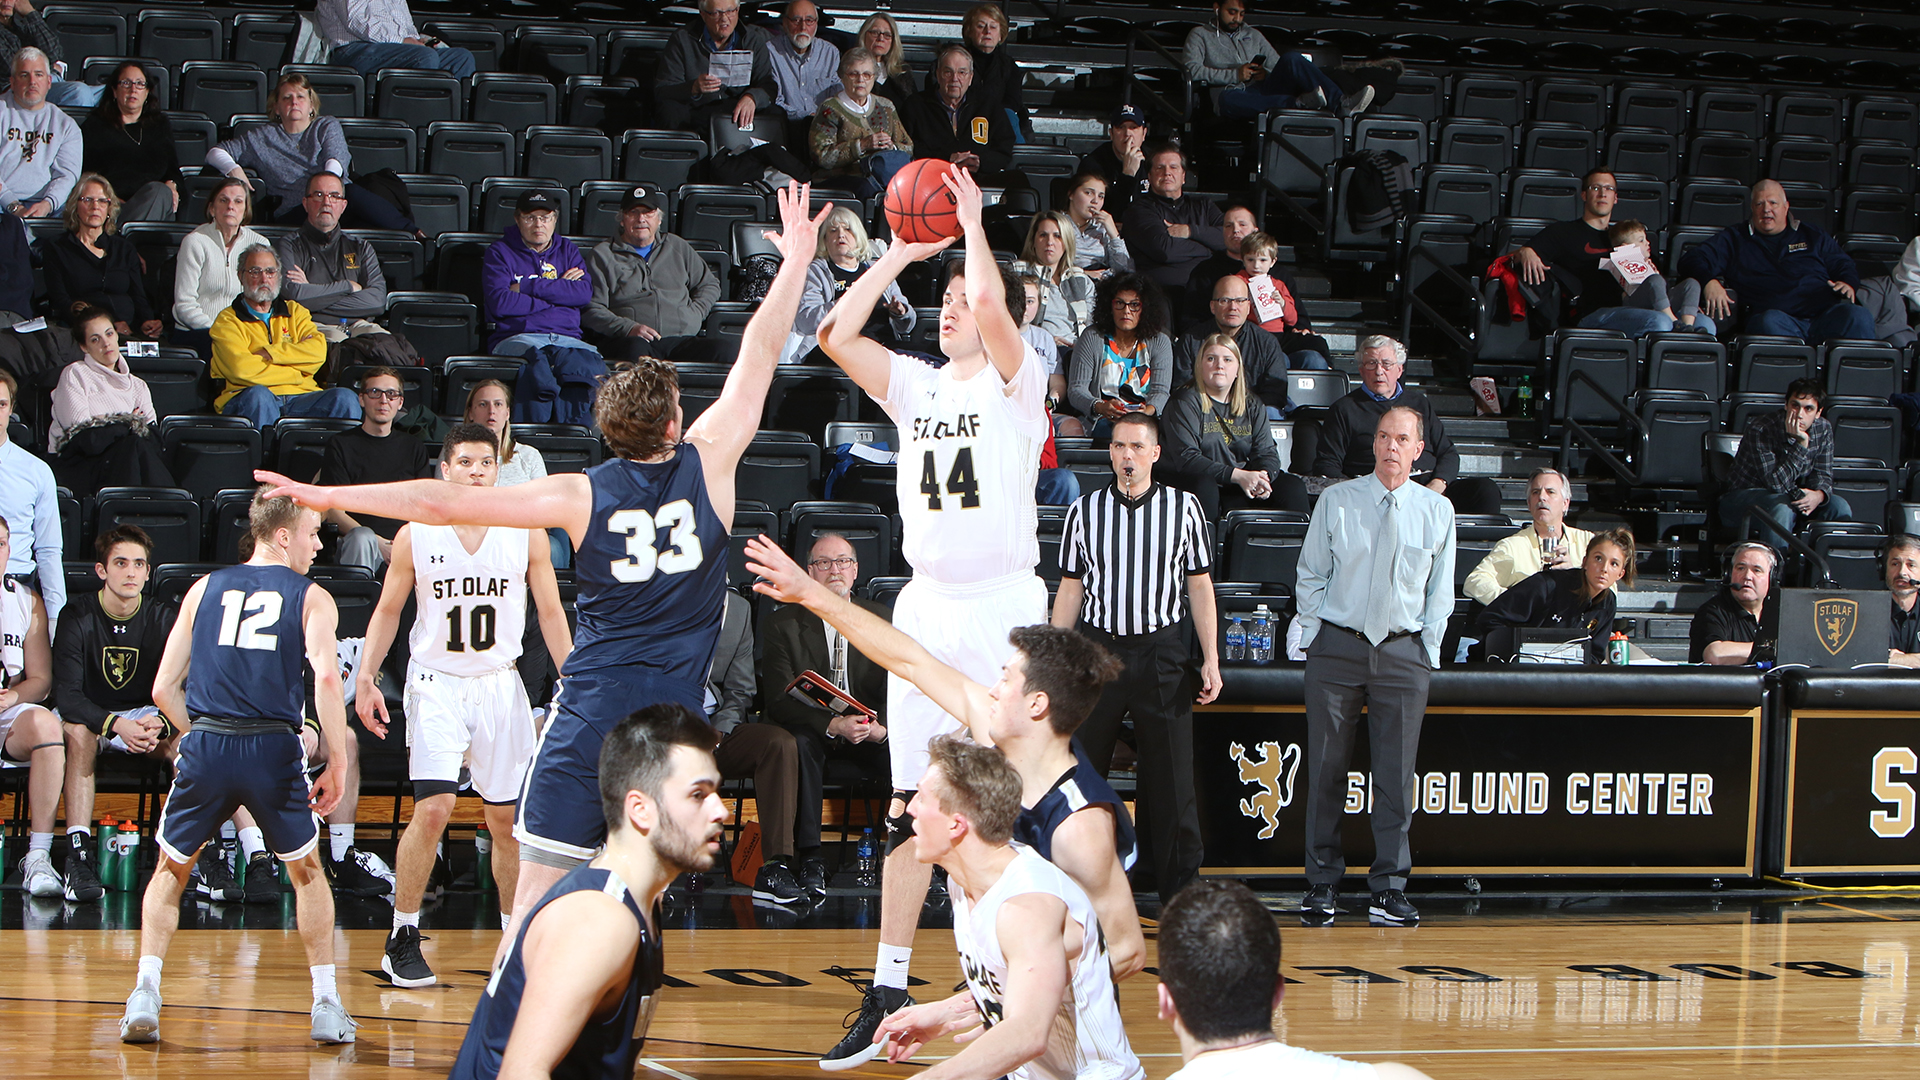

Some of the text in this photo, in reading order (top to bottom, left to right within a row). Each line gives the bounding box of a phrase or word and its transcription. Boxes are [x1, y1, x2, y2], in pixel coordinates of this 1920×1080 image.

[860, 432, 869, 440] 11
[913, 413, 981, 441] ST. OLAF
[1273, 429, 1284, 438] 15
[920, 446, 981, 511] 44
[607, 498, 703, 584] 33
[433, 577, 509, 600] ST. OLAF
[1819, 604, 1853, 617] ST. OLAF
[218, 588, 284, 652] 12
[446, 604, 496, 653] 10
[1344, 772, 1714, 816] SGLUND CENTER
[1869, 746, 1918, 838] S
